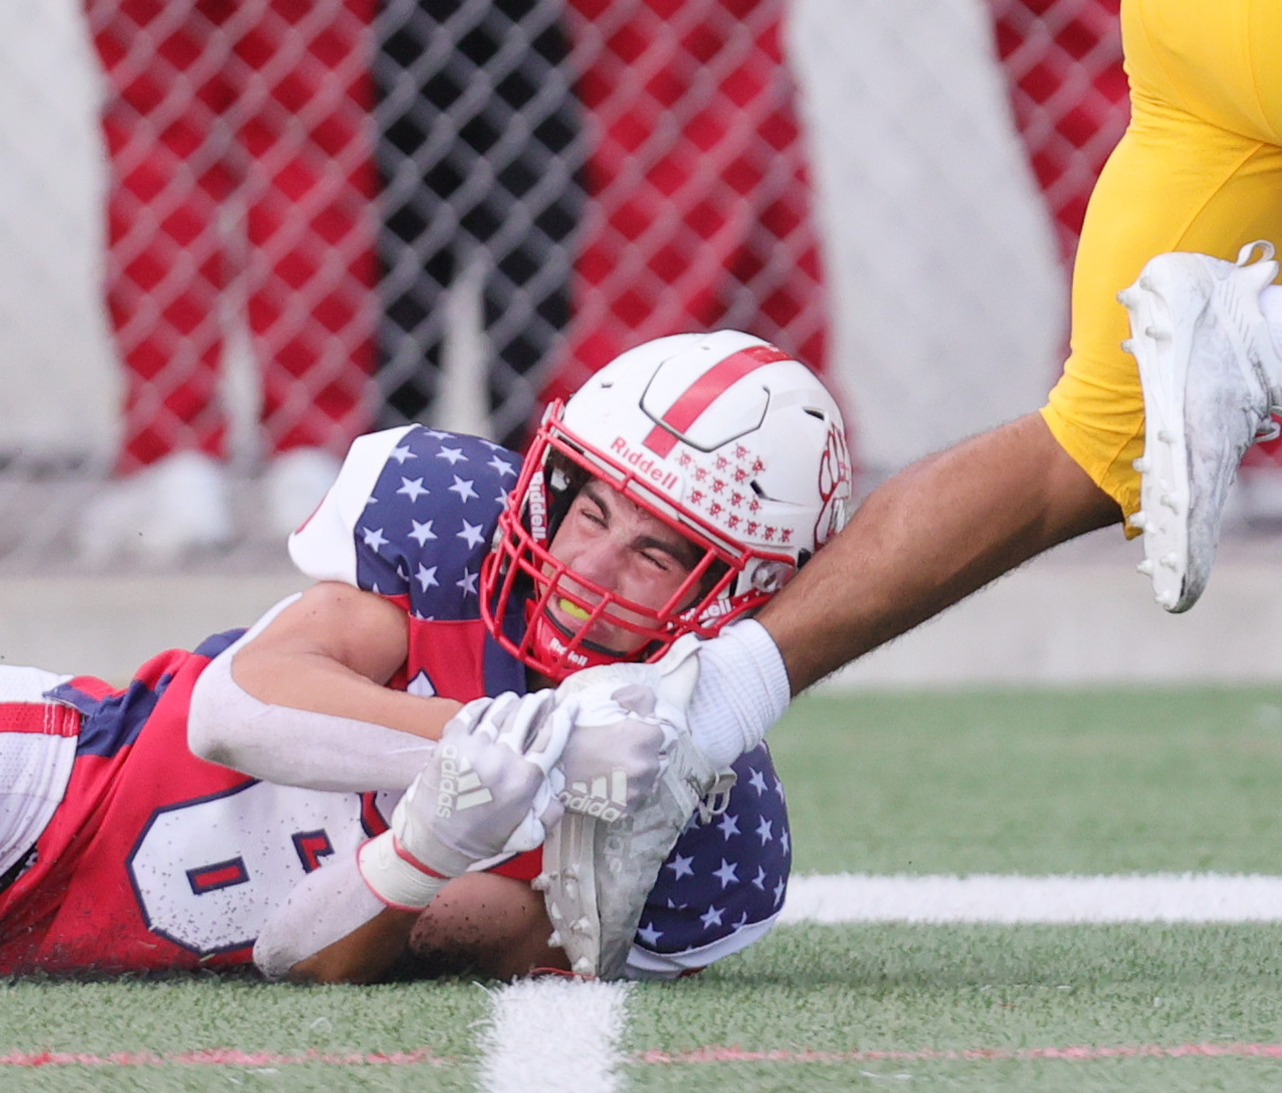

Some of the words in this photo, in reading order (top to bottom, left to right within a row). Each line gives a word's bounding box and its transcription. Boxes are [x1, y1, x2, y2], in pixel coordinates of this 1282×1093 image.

[610, 436, 678, 490] Riddell
[437, 744, 461, 819] adidas
[558, 790, 626, 823] adida
